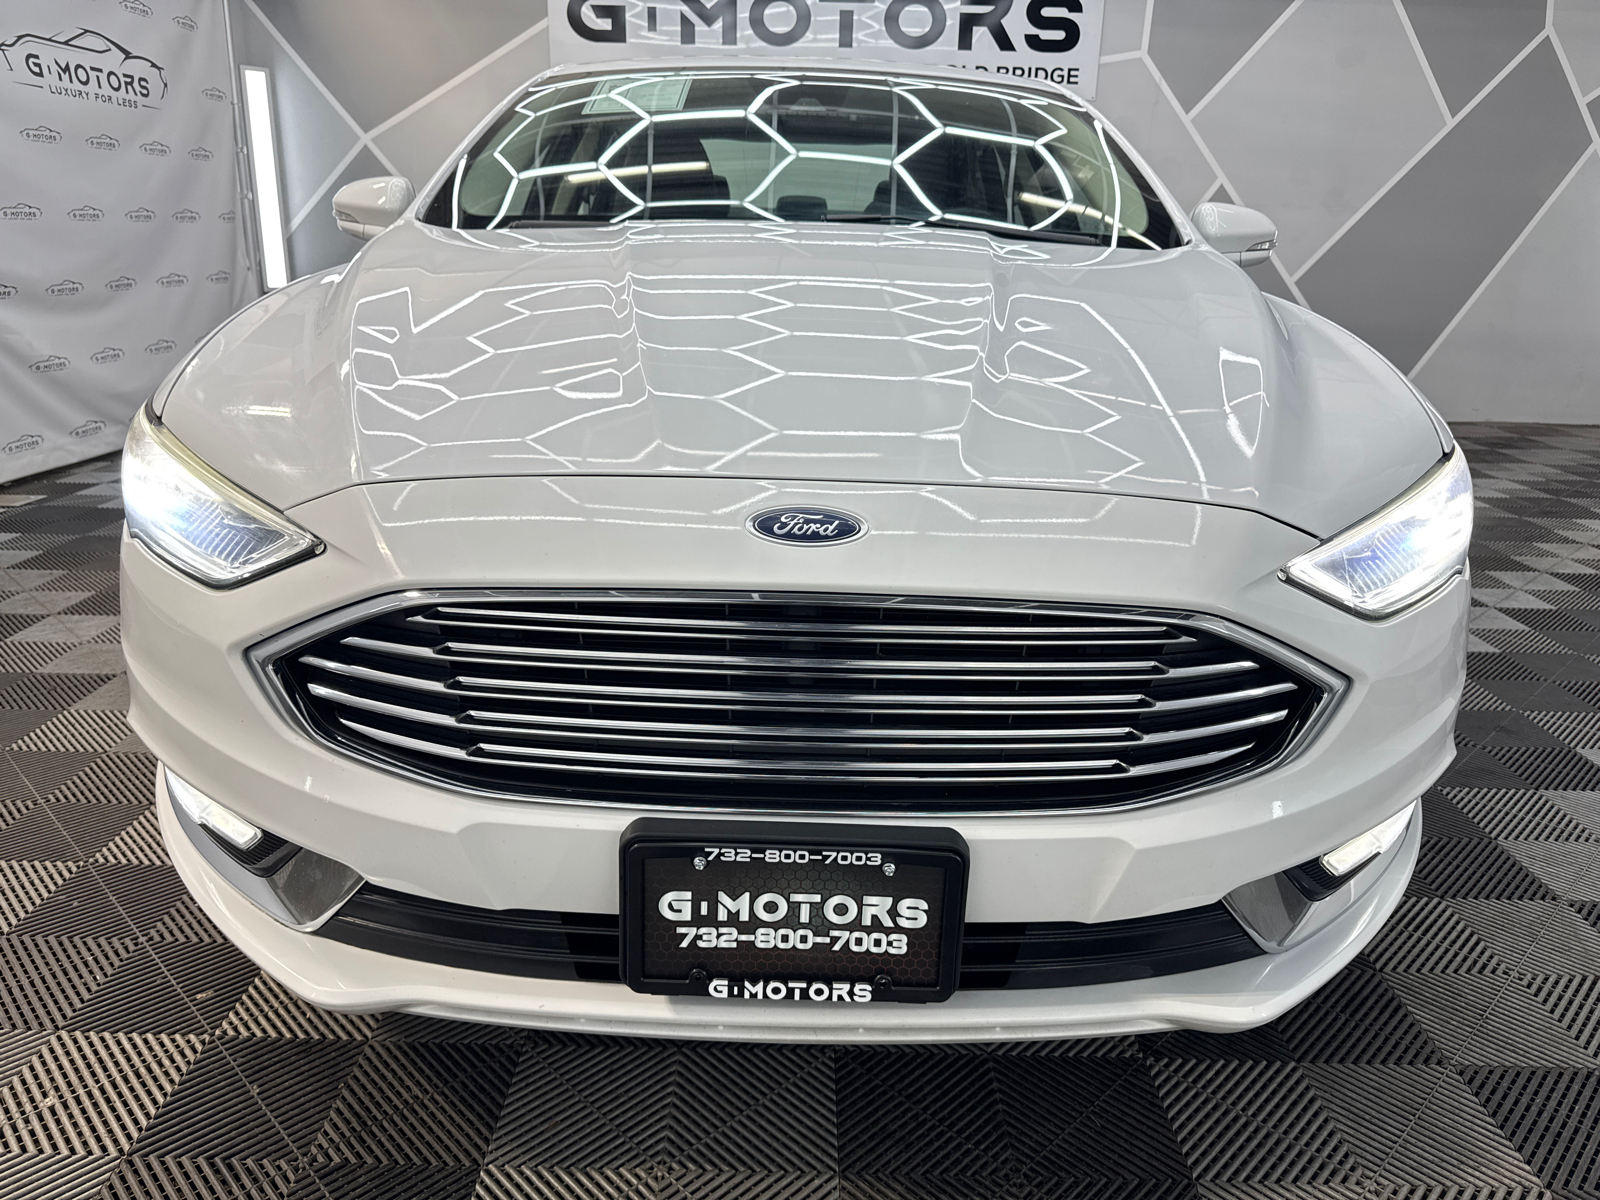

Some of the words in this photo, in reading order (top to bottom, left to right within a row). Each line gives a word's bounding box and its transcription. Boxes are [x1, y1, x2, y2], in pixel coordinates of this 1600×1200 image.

[49, 84, 90, 100] LUXURY
[94, 93, 113, 105] FOR
[117, 97, 138, 109] LESS
[773, 513, 839, 536] Ford
[704, 847, 882, 866] 732-800-7003
[675, 926, 908, 955] 732-800-7003
